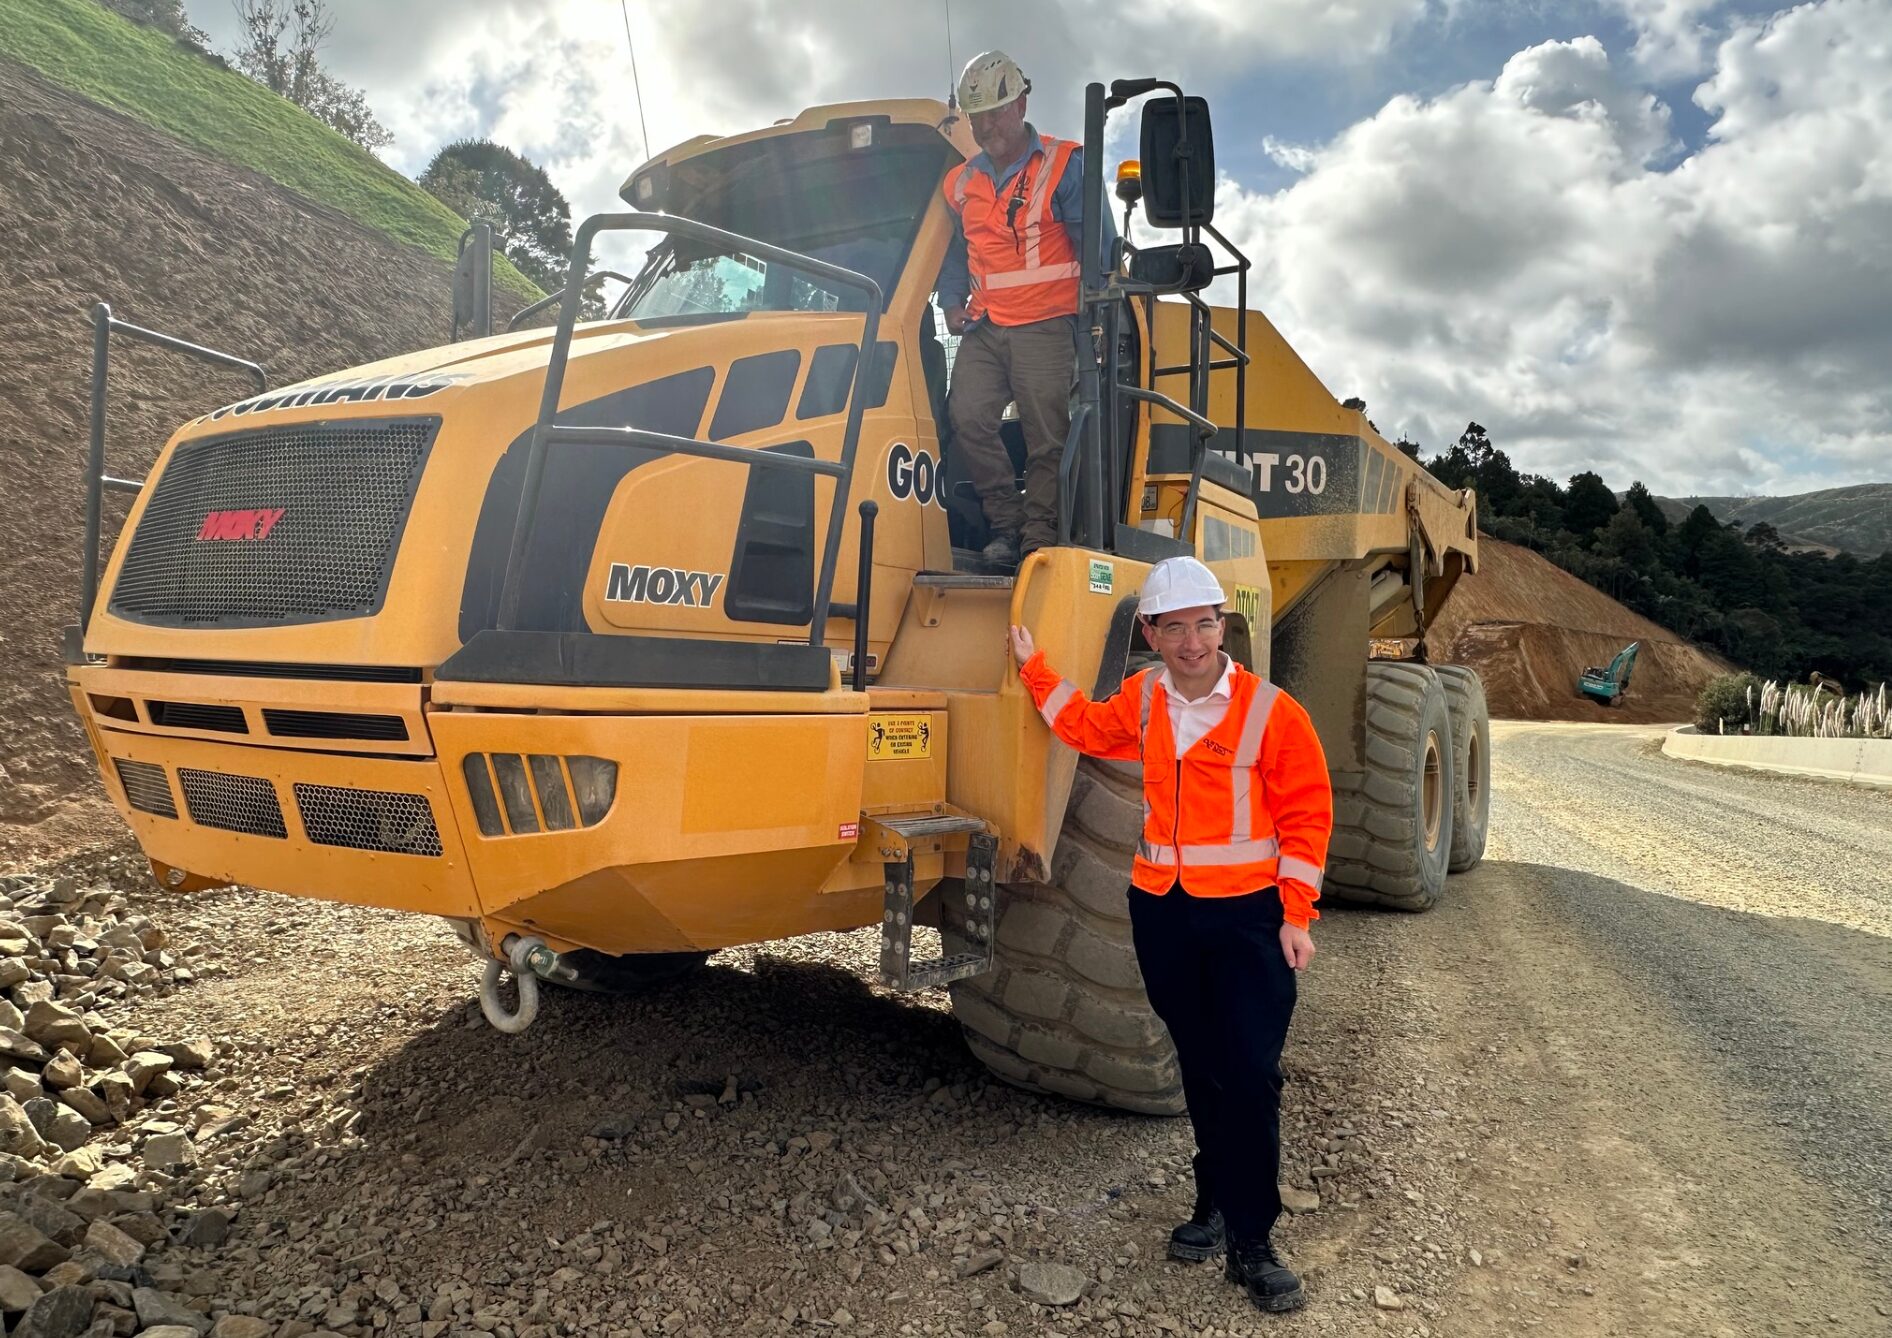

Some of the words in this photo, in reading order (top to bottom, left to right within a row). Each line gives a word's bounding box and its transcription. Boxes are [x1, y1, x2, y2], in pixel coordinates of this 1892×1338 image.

[1284, 454, 1327, 495] 30
[195, 508, 286, 541] MOXY
[605, 562, 725, 608] MOXY
